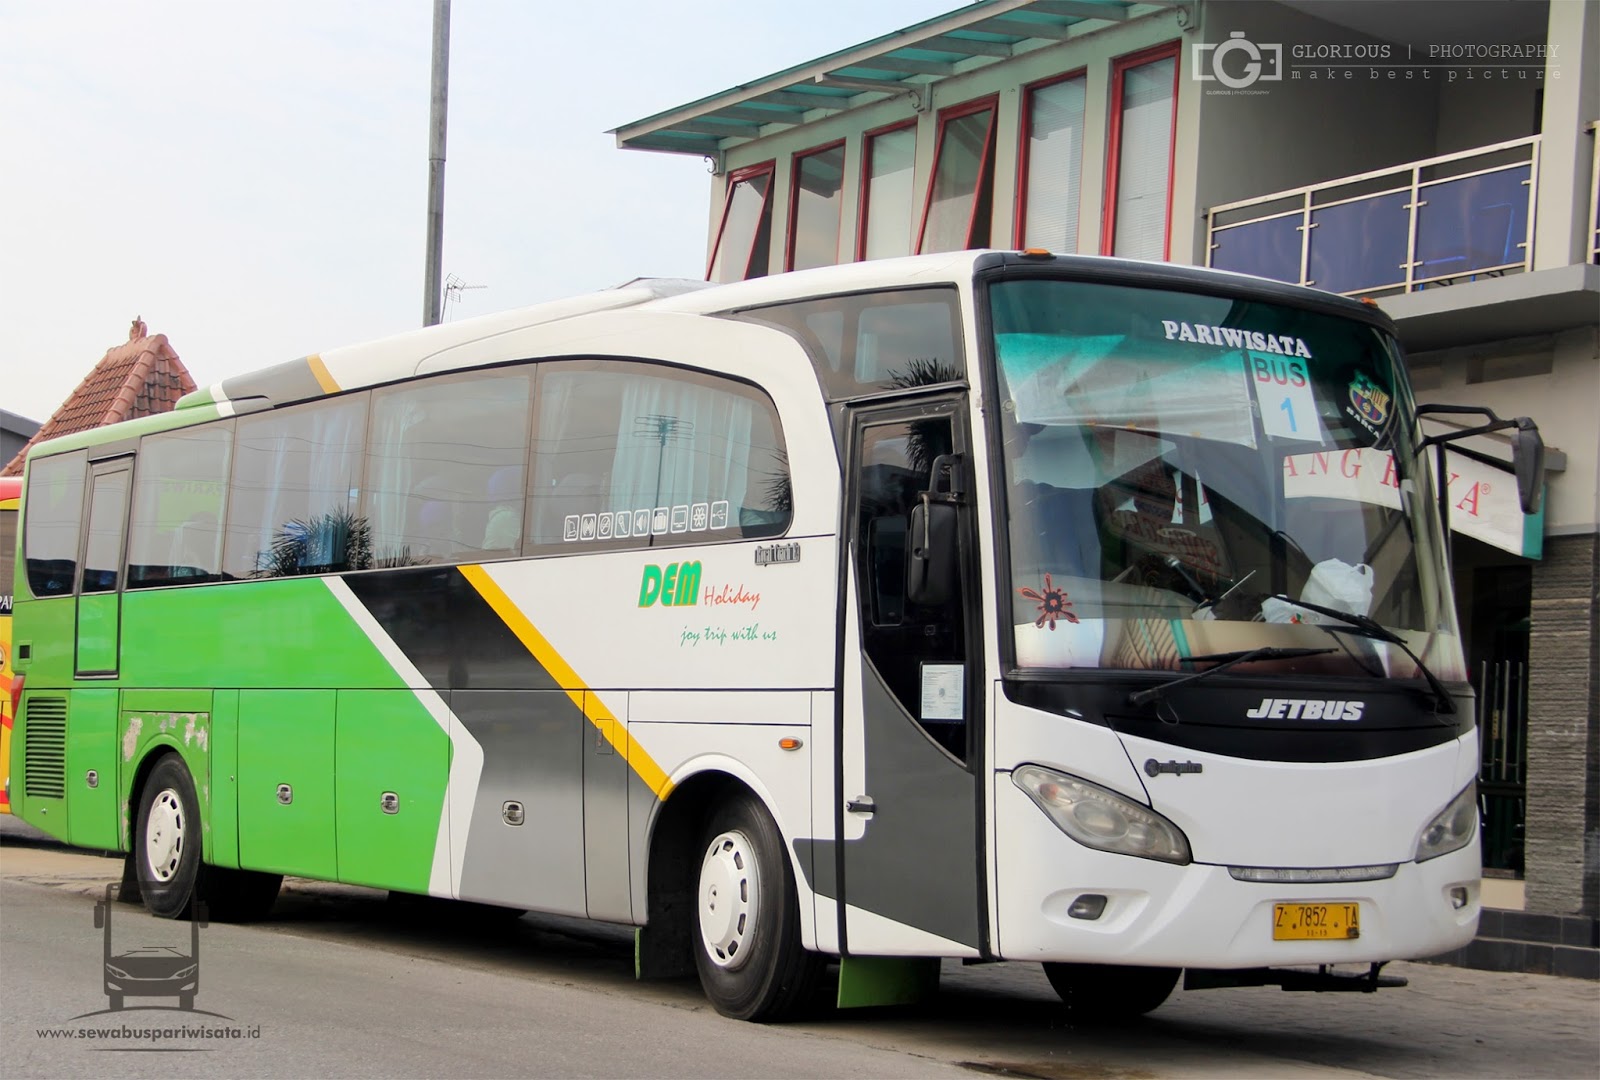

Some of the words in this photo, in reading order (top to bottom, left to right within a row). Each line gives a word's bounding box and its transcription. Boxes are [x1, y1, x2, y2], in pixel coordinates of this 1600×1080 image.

[1161, 320, 1312, 359] PARIWISATA
[1253, 357, 1306, 388] BUS
[1280, 397, 1298, 432] 1
[637, 559, 703, 608] DEM
[704, 583, 761, 611] Holiday
[680, 625, 701, 647] joy
[704, 626, 728, 646] trip
[731, 623, 758, 640] with
[762, 630, 777, 640] us
[1246, 698, 1365, 721] JETBUS
[1276, 906, 1284, 927] Z
[1298, 906, 1327, 927] 7852
[1343, 906, 1358, 927] TA
